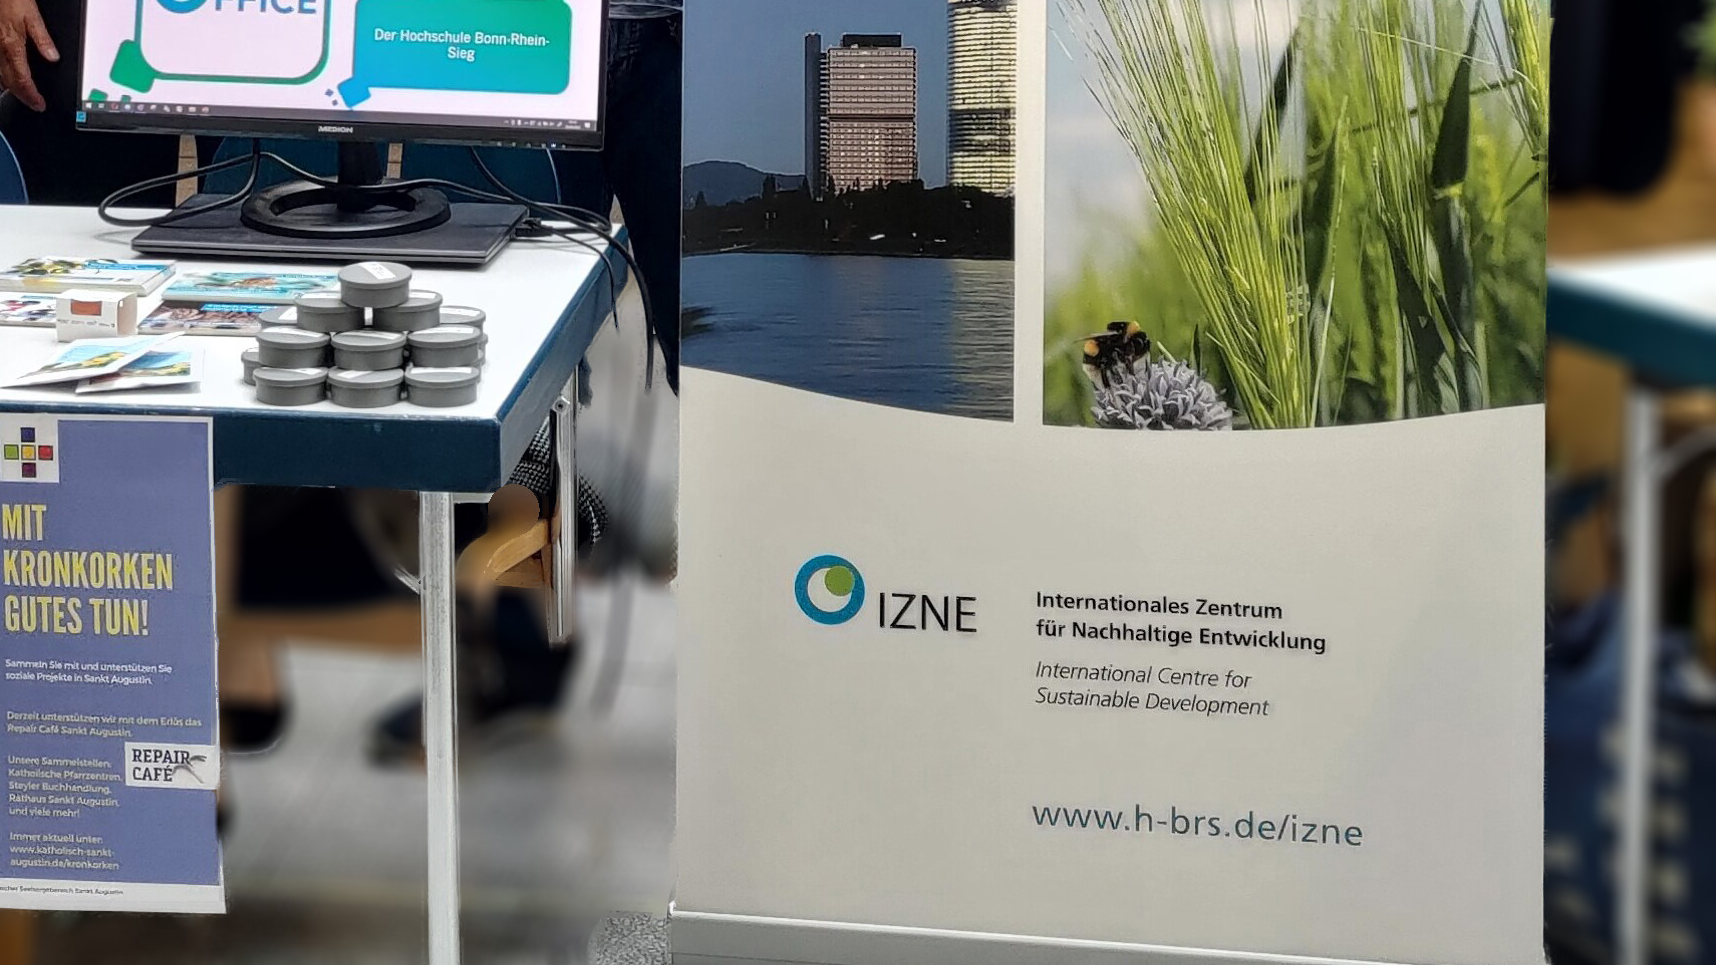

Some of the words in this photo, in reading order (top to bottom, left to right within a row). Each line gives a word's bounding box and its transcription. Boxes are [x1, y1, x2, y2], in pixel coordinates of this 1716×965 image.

[373, 28, 398, 43] Der
[400, 29, 471, 44] Hochschule
[474, 31, 550, 47] Bonn-Rhein-
[447, 45, 475, 62] Sieg
[318, 125, 354, 133] MEDION
[2, 503, 47, 541] MIT
[3, 549, 173, 591] KRONKORKEN
[4, 595, 83, 634] GUTES
[89, 597, 149, 636] TUN!
[879, 592, 978, 634] IZNE
[1036, 591, 1189, 615] Internationales
[1196, 599, 1283, 620] Zentrum
[1036, 619, 1066, 638] für
[1072, 621, 1193, 647] Nachhaltige
[1199, 628, 1327, 655] Entwicklung
[6, 659, 48, 669] Sammeln
[49, 660, 62, 669] Sie
[64, 661, 79, 670] mit
[81, 662, 99, 671] und
[158, 664, 172, 674] Sie
[1035, 661, 1153, 684] International
[1158, 666, 1219, 687] Centre
[1224, 669, 1253, 689] for
[36, 673, 73, 683] Projekte
[74, 674, 82, 682] in
[84, 674, 110, 684] Sankt
[1035, 687, 1140, 709] Sustainable
[1145, 692, 1269, 717] Development
[7, 723, 37, 734] Repair
[60, 725, 88, 735] Sankt
[136, 716, 159, 725] dem
[184, 718, 202, 727] das
[132, 749, 190, 765] REPAIR
[132, 764, 173, 782] CAFÉ
[1031, 803, 1364, 848] www.h-brs.de/izne
